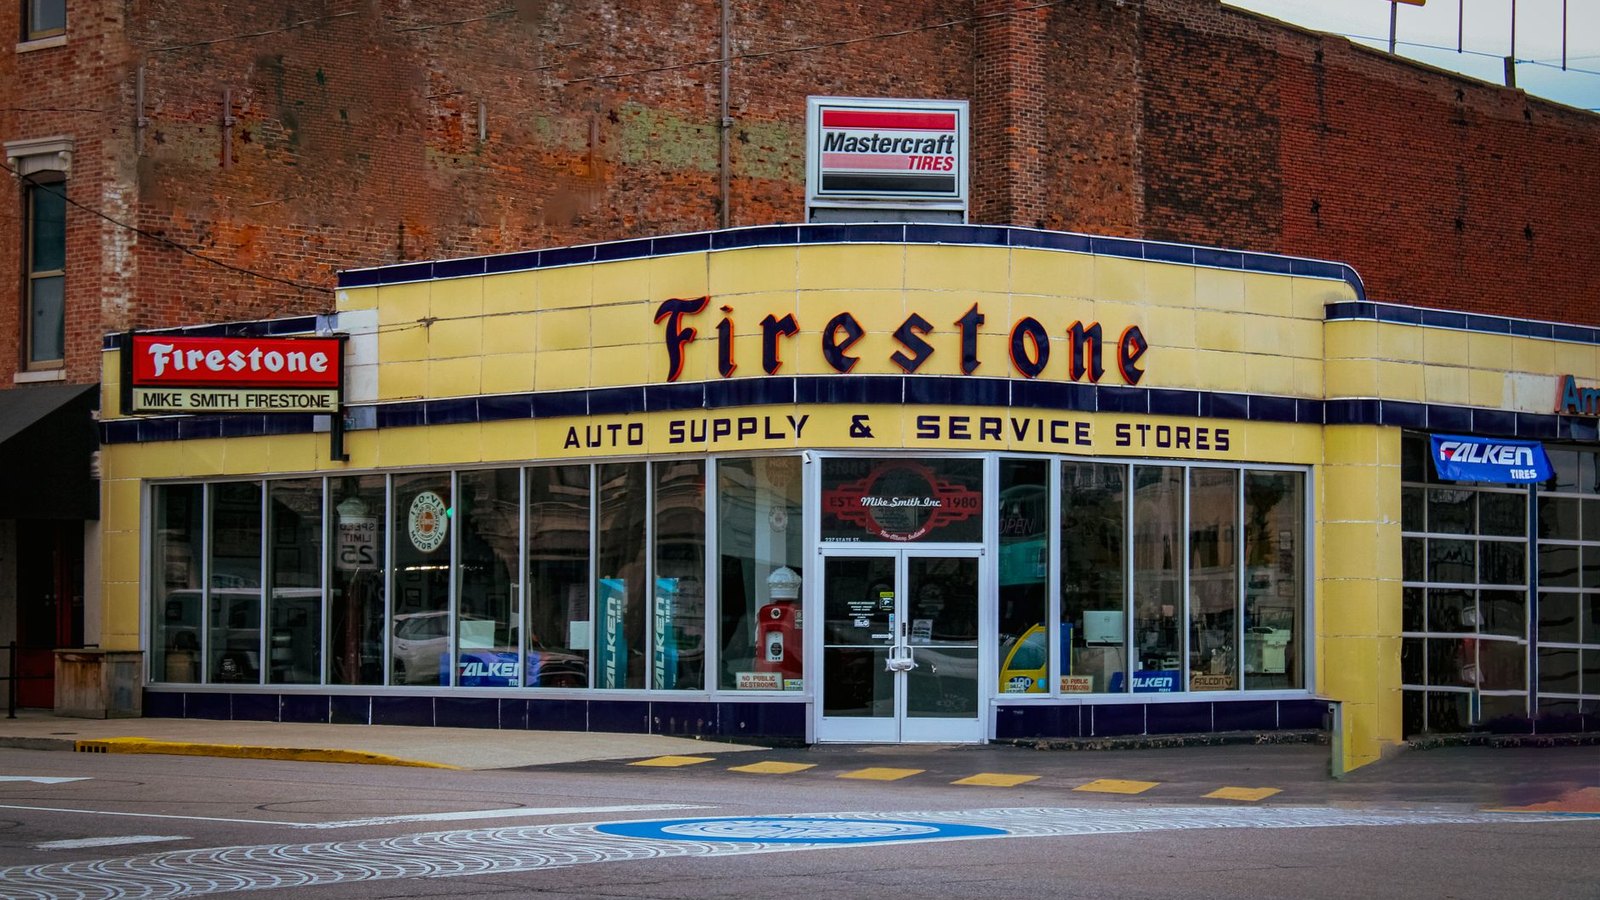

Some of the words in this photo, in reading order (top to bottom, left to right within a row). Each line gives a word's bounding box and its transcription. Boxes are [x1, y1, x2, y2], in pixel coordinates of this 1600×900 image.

[823, 132, 955, 154] Mastercraft
[908, 155, 954, 171] TIRES
[654, 295, 1148, 385] Firestone
[148, 343, 329, 377] Firestone
[143, 393, 182, 408] MIKE
[190, 393, 239, 408] SMITH
[245, 394, 330, 408] FIRESTONE
[564, 422, 643, 449] AUTO
[669, 415, 809, 444] SUPPLY
[850, 415, 874, 438] &
[916, 415, 1091, 446] SERVICE
[1115, 423, 1229, 451] STORES
[1440, 441, 1533, 466] FALKEN
[1510, 469, 1537, 480] TIRES
[411, 494, 445, 516] ISO-VIS
[830, 497, 853, 508] EST.
[860, 497, 888, 508] Mike
[889, 497, 921, 508] Smith
[922, 497, 942, 508] Inc.
[946, 497, 977, 508] 1980
[411, 530, 432, 550] MOTOR
[433, 530, 444, 545] OIL
